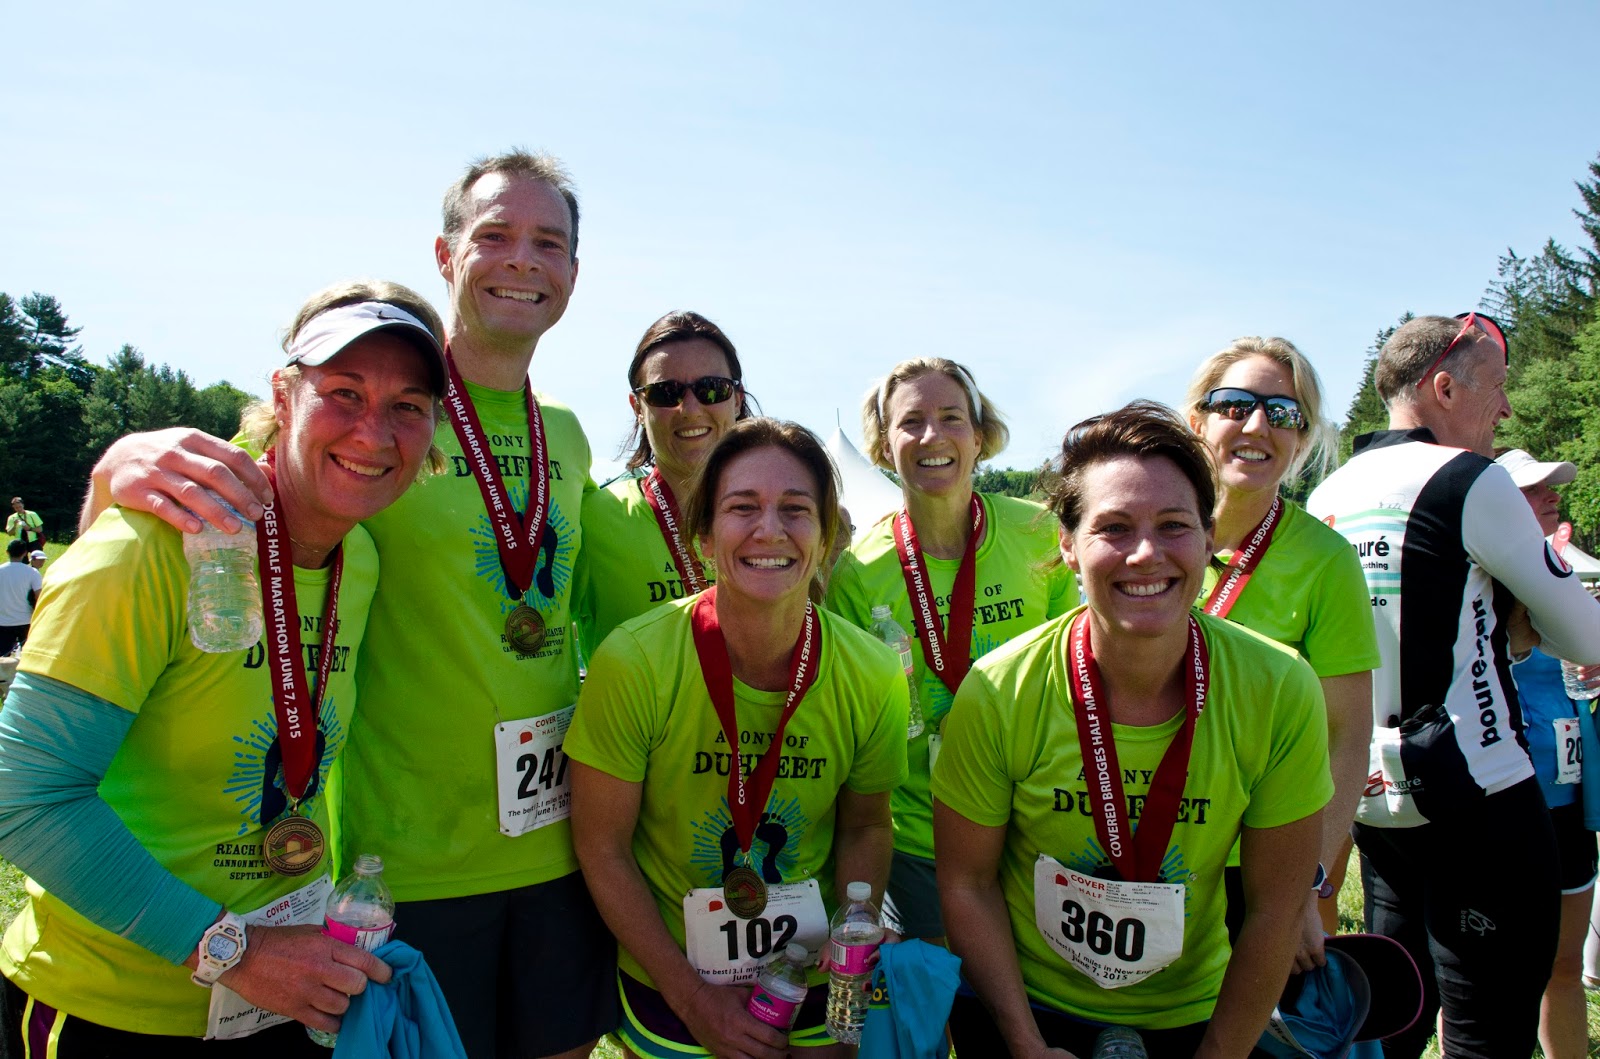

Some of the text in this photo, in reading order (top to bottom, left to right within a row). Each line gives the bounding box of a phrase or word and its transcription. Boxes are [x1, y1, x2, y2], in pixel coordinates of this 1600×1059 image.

[536, 438, 544, 465] HALF
[450, 395, 468, 423] HALF
[461, 424, 494, 485] MARATHON
[487, 484, 504, 512] JUNE
[500, 523, 518, 550] 2015
[537, 466, 546, 505] BRIDGES
[262, 500, 278, 537] DGES
[528, 505, 544, 546] OVERED
[267, 537, 282, 574] HALF
[662, 510, 679, 533] HALF
[672, 532, 698, 586] MARATHON
[900, 522, 919, 570] MARATHON
[1209, 508, 1277, 616] BRIDGES HALF MARATHON
[911, 568, 925, 592] HALF
[984, 583, 1003, 597] OF
[270, 576, 289, 656] MARATHON
[918, 591, 935, 631] BRIDGES
[801, 614, 814, 662] BRIDGES
[927, 631, 945, 672] COVERED
[1191, 629, 1205, 681] BRIDGES
[321, 629, 335, 684] BRIDGES
[279, 656, 295, 697] JUNE
[793, 661, 808, 691] HALF
[1075, 645, 1099, 713] MARATHON
[286, 706, 302, 740] 2015
[535, 715, 556, 728] COVER
[1087, 712, 1105, 746] HALF
[715, 730, 810, 749] AONY OF
[516, 743, 570, 801] 247
[692, 751, 827, 779] DUHEET
[1095, 746, 1113, 802] BRIDGES
[507, 810, 521, 818] The
[545, 797, 558, 806] miles
[535, 806, 551, 820] June
[558, 798, 571, 810] 201
[1104, 802, 1122, 858] COVERED
[213, 859, 248, 868] CANNON
[216, 843, 256, 856] REACH
[229, 871, 273, 880] SEPTEMB
[1070, 873, 1106, 891] COVER
[266, 900, 290, 919] COVER
[1078, 888, 1103, 899] HALF
[274, 914, 291, 926] HALF
[1061, 899, 1146, 962] 360
[719, 914, 798, 961] 102
[696, 968, 711, 976] The
[732, 973, 753, 983] June
[1071, 954, 1091, 970] June
[1102, 971, 1128, 981] 2015
[1083, 955, 1102, 969] miles
[1103, 964, 1112, 972] in
[1114, 967, 1133, 976] New
[218, 1014, 235, 1026] The
[237, 1006, 255, 1018] best
[257, 1010, 278, 1024] Jun
